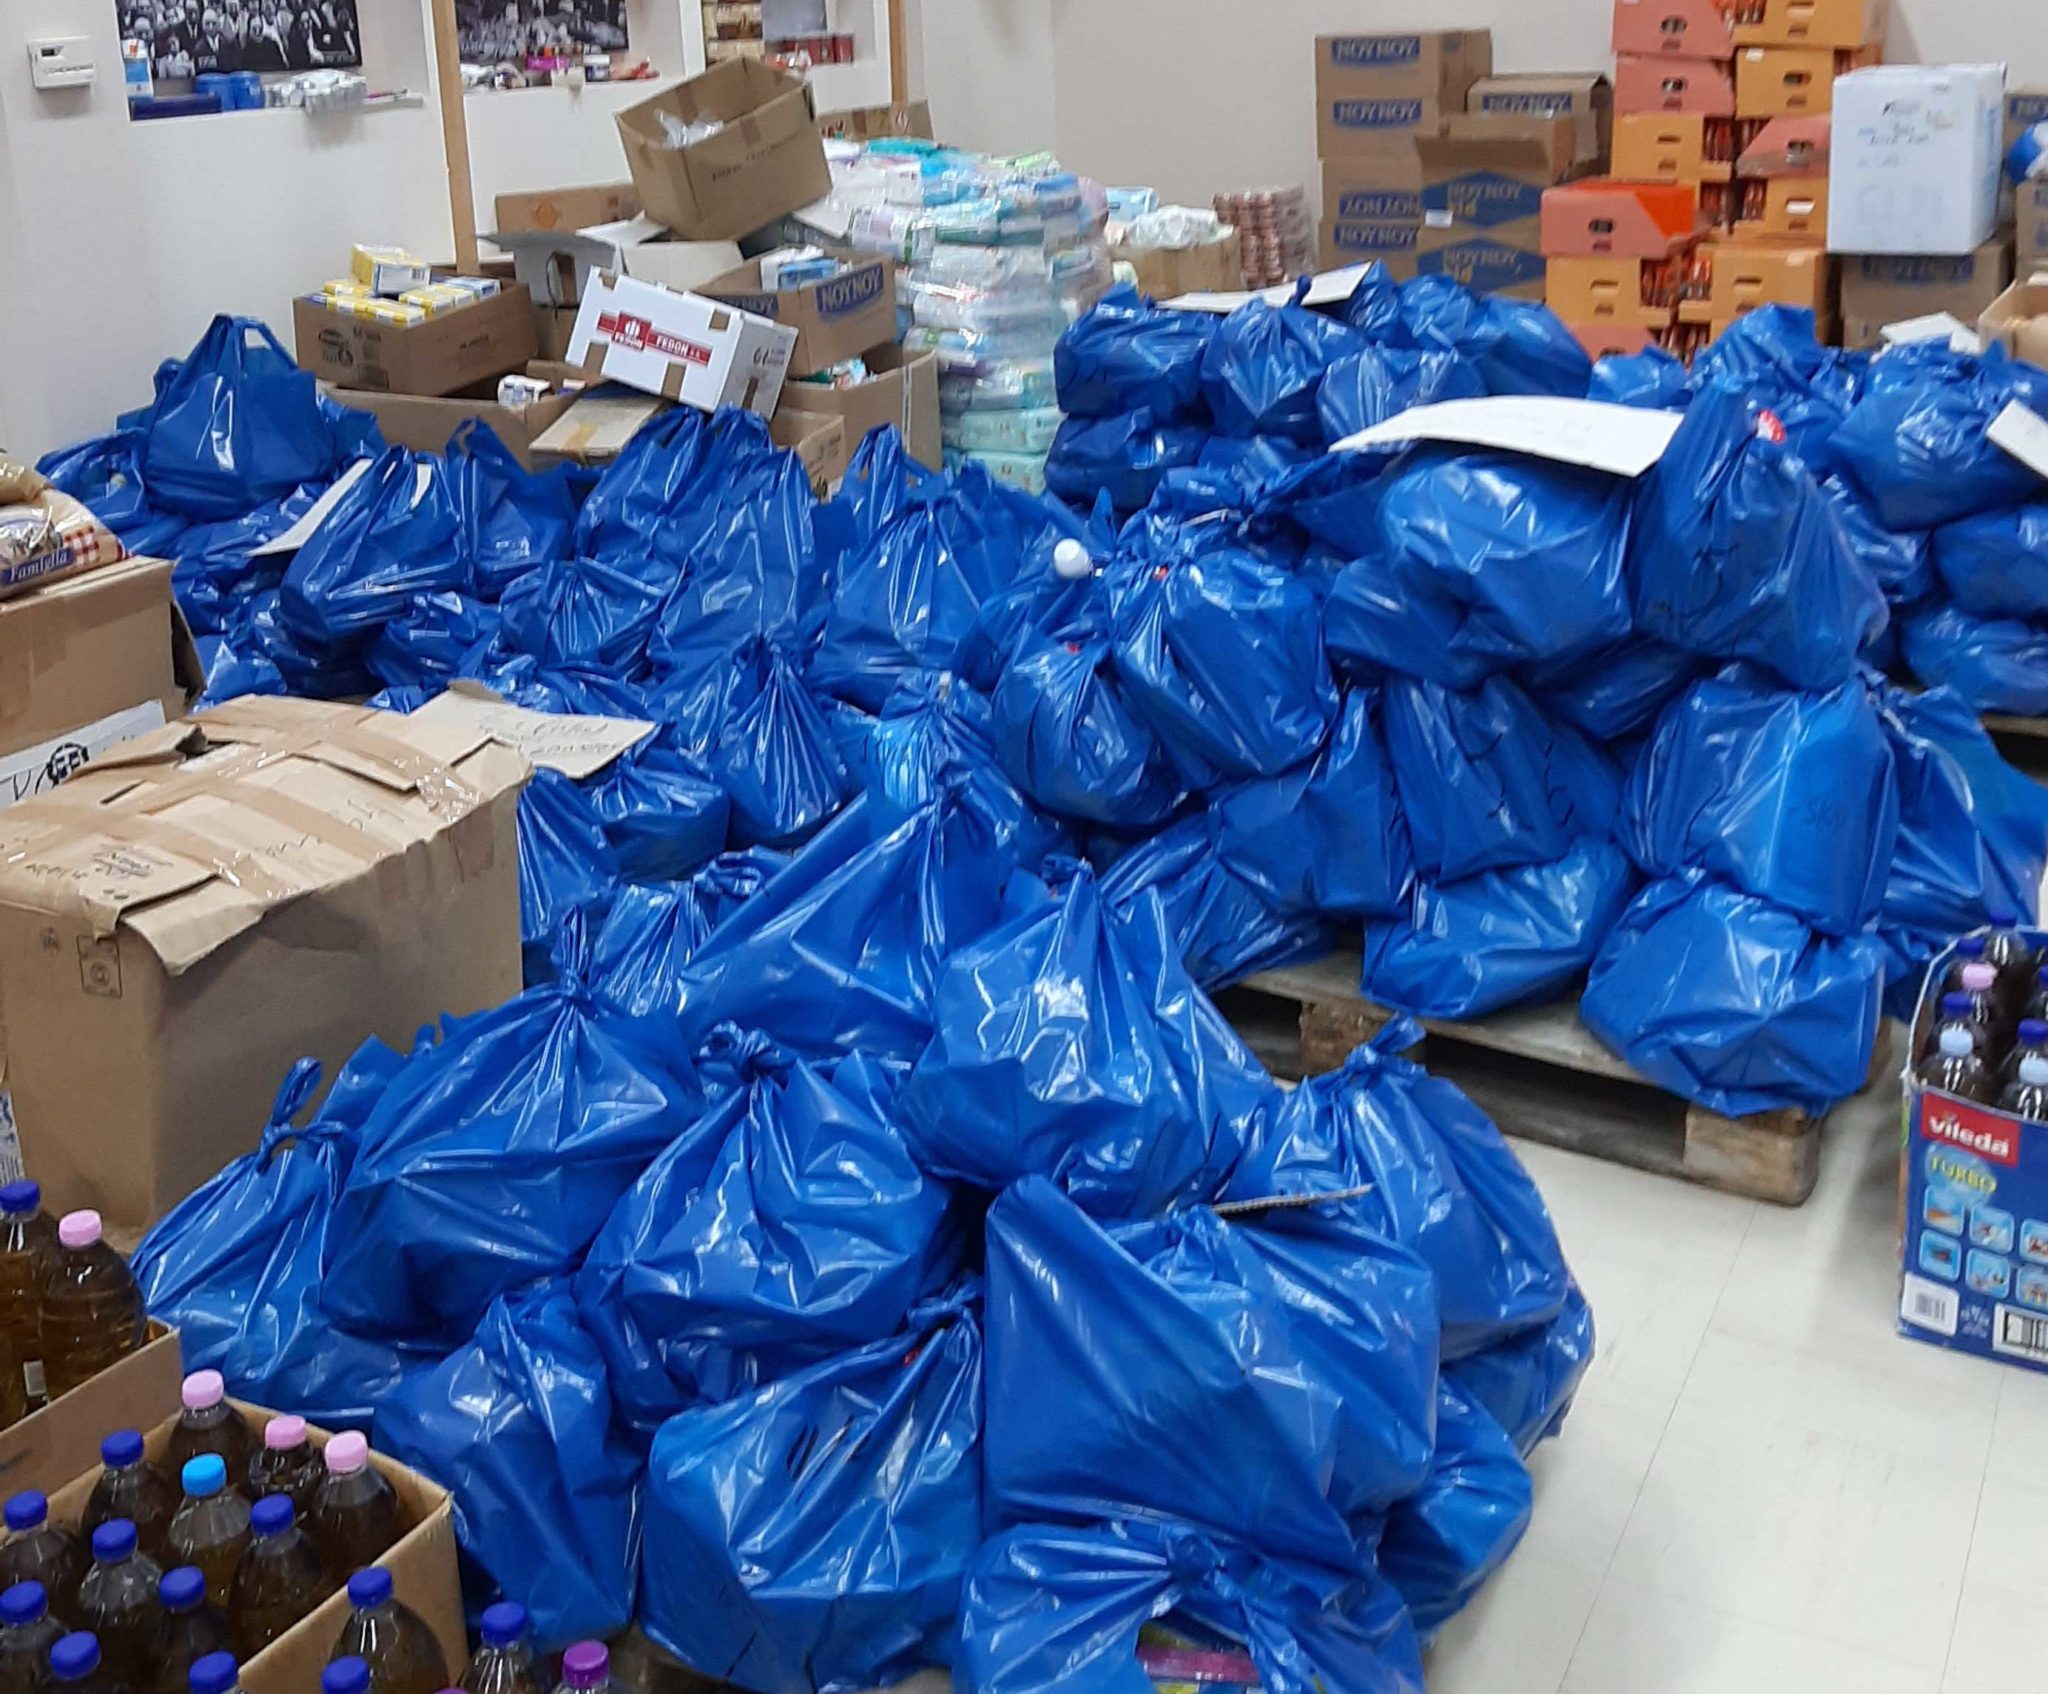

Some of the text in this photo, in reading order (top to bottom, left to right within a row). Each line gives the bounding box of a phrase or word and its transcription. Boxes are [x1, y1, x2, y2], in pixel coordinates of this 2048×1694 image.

[821, 266, 881, 314] NOYNOY
[655, 335, 689, 357] FEDON
[10, 547, 68, 582] Famiglia
[1928, 1111, 2010, 1158] vileda
[1931, 1156, 1997, 1194] TURBO
